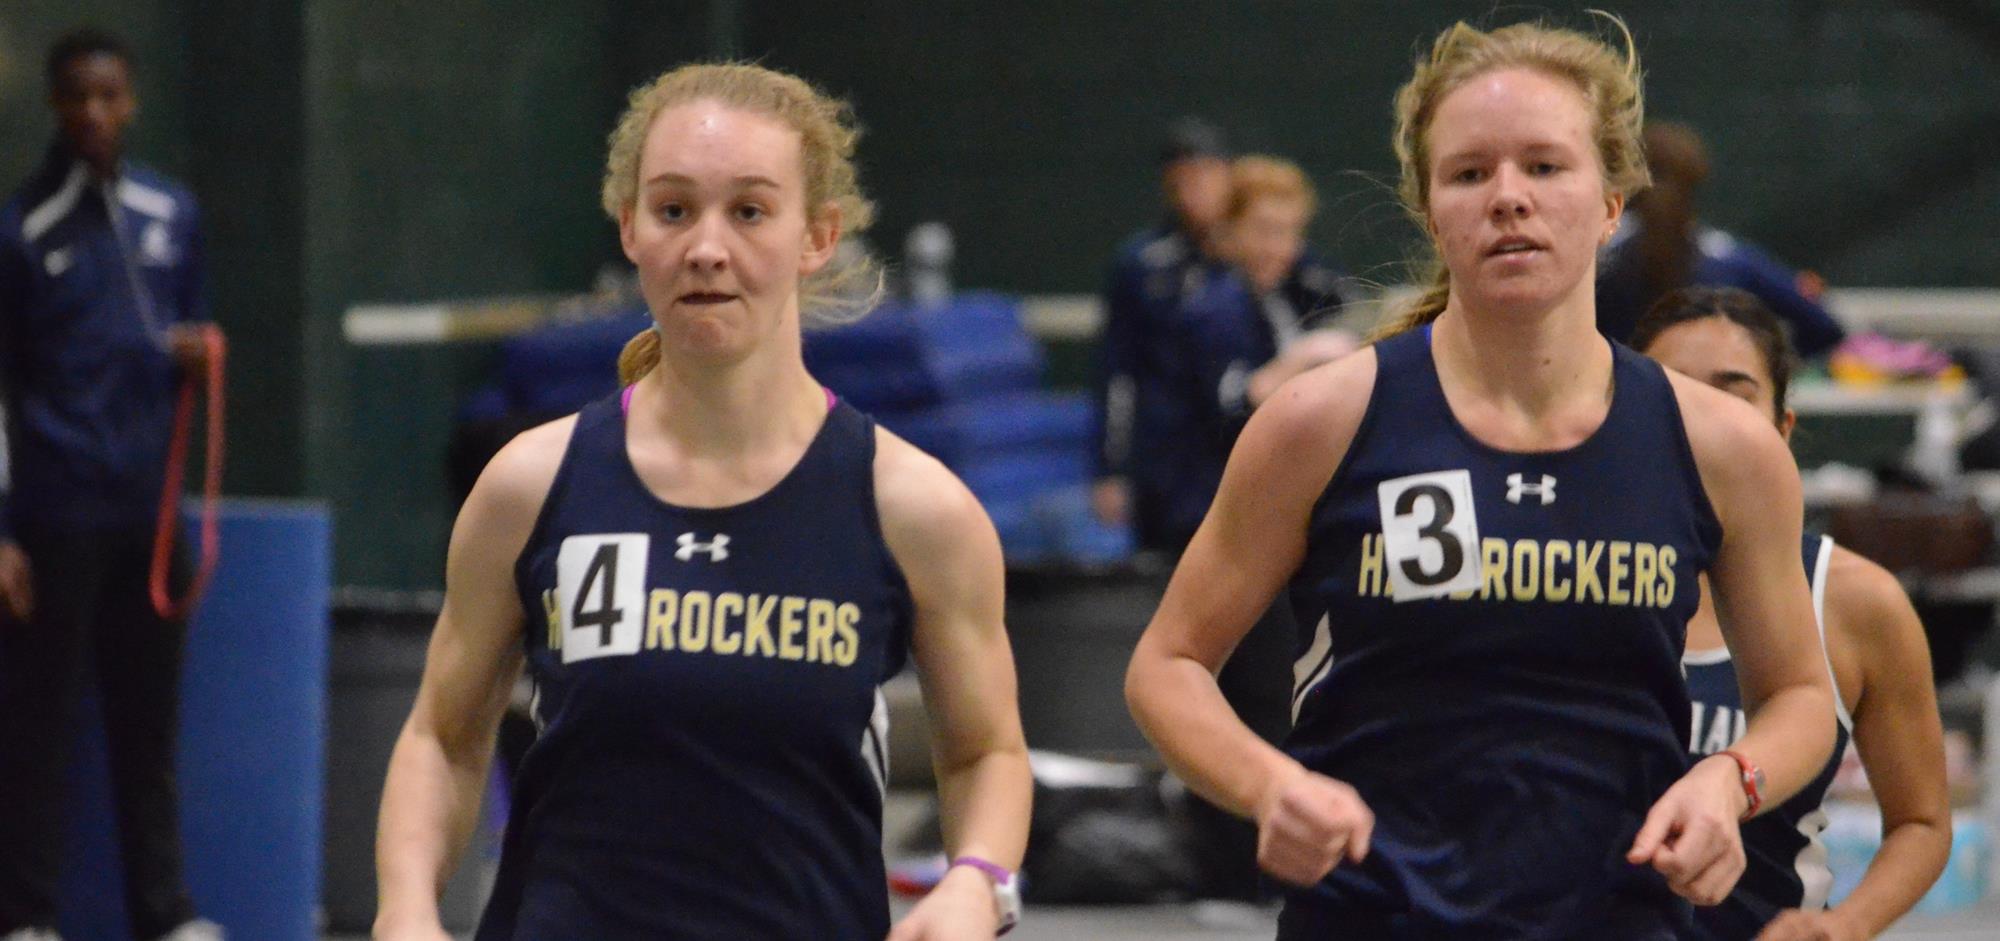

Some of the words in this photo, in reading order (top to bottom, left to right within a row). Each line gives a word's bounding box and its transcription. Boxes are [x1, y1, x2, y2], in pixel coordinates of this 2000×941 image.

[1358, 532, 1677, 608] HROCKERS
[1394, 484, 1464, 586] 3
[542, 587, 861, 667] HROCKERS
[571, 542, 624, 647] 4
